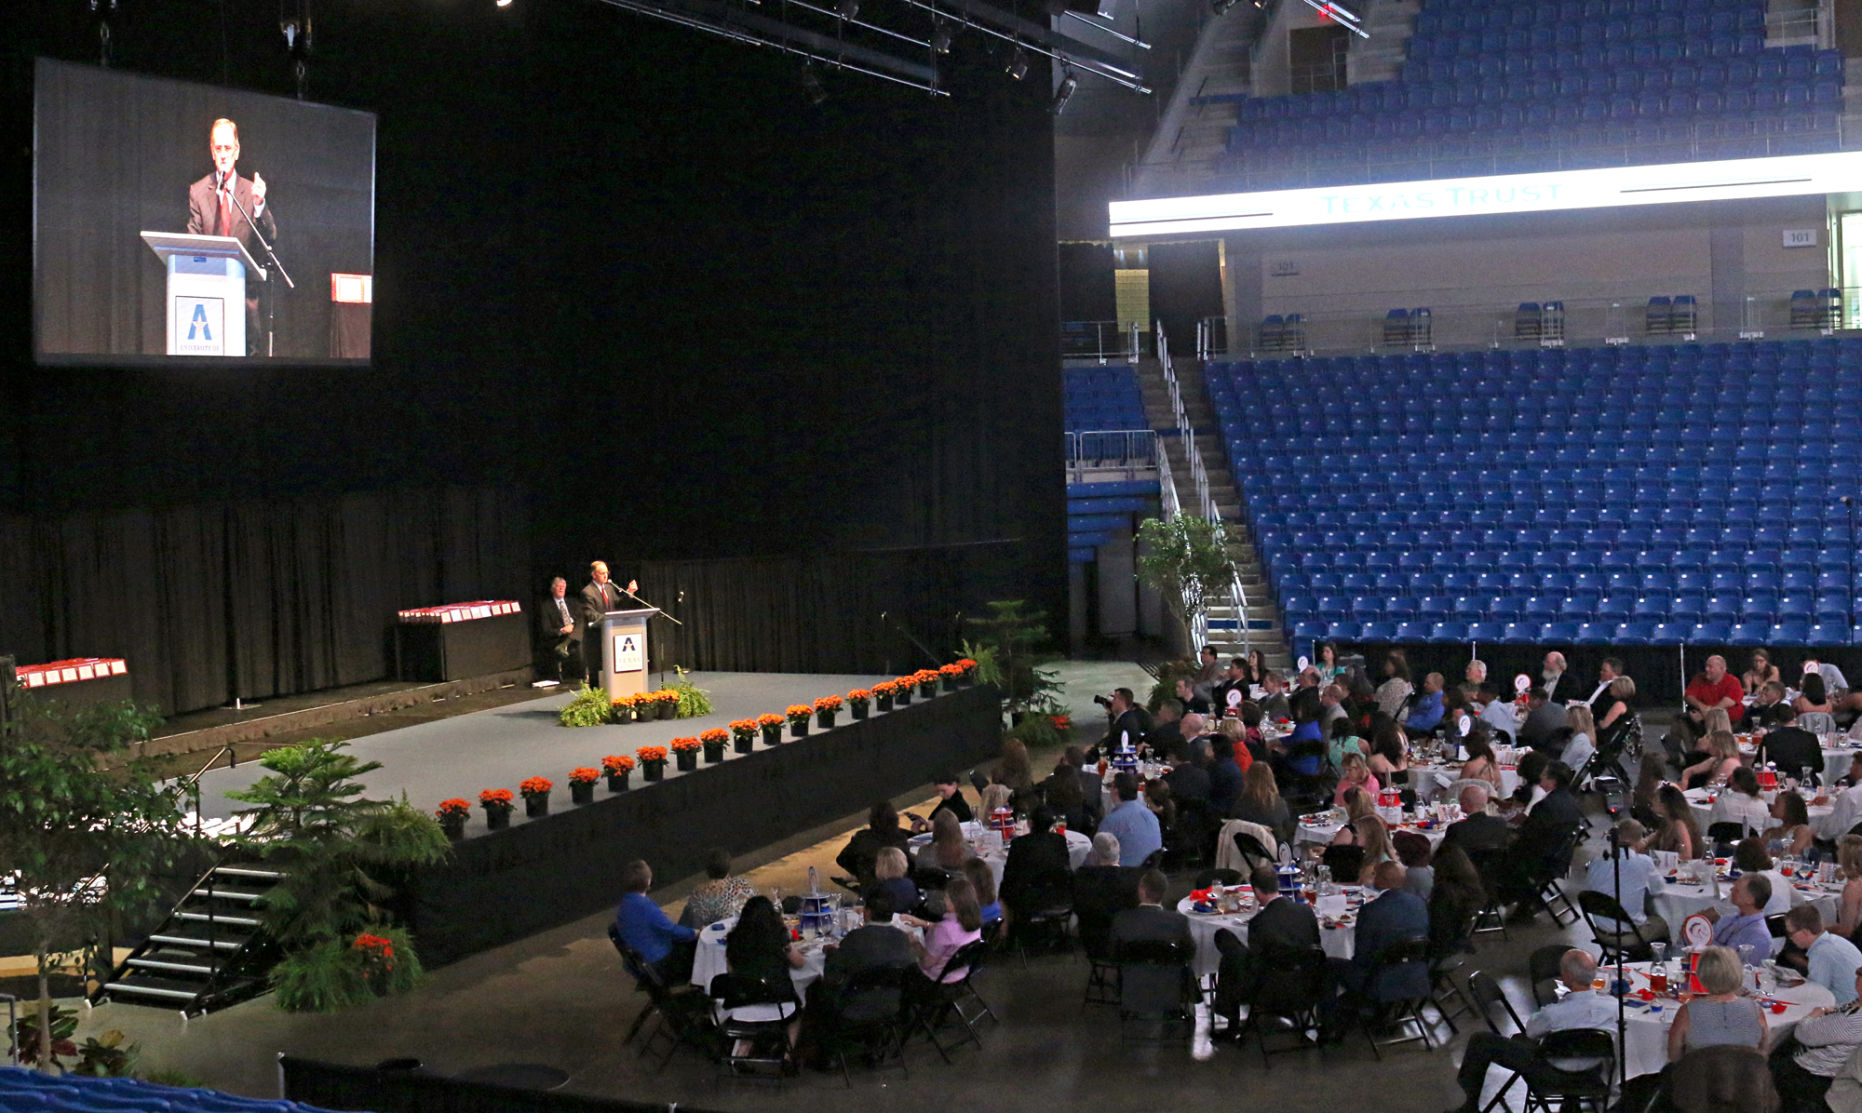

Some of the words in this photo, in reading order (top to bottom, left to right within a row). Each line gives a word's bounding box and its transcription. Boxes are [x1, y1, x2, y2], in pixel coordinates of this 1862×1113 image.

[1320, 192, 1435, 215] TEXAS
[1446, 183, 1564, 207] TRUST
[1791, 232, 1809, 243] 101
[187, 304, 212, 340] A
